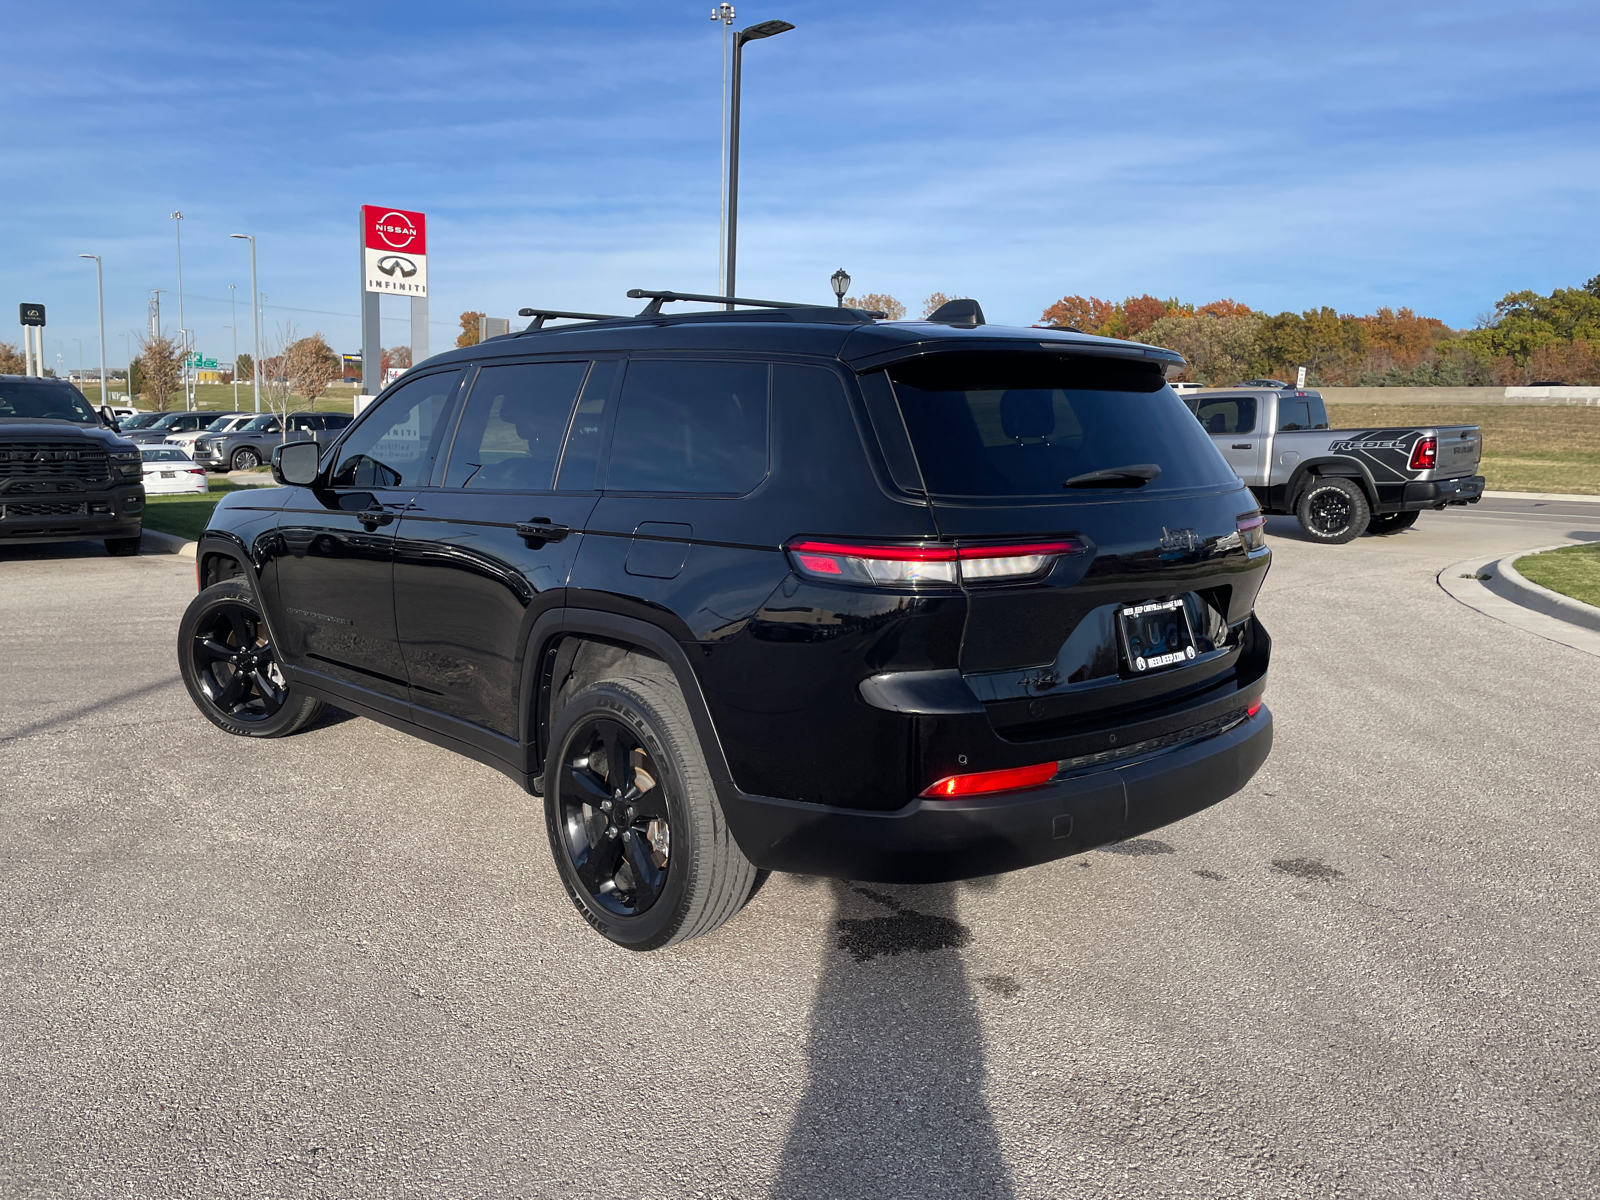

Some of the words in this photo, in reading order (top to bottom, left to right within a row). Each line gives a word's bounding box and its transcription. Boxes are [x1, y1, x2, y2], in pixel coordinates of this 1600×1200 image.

[375, 224, 417, 236] NISSAN
[369, 279, 426, 293] INFINITI
[375, 443, 410, 451] Certified
[1328, 439, 1406, 451] REBEL
